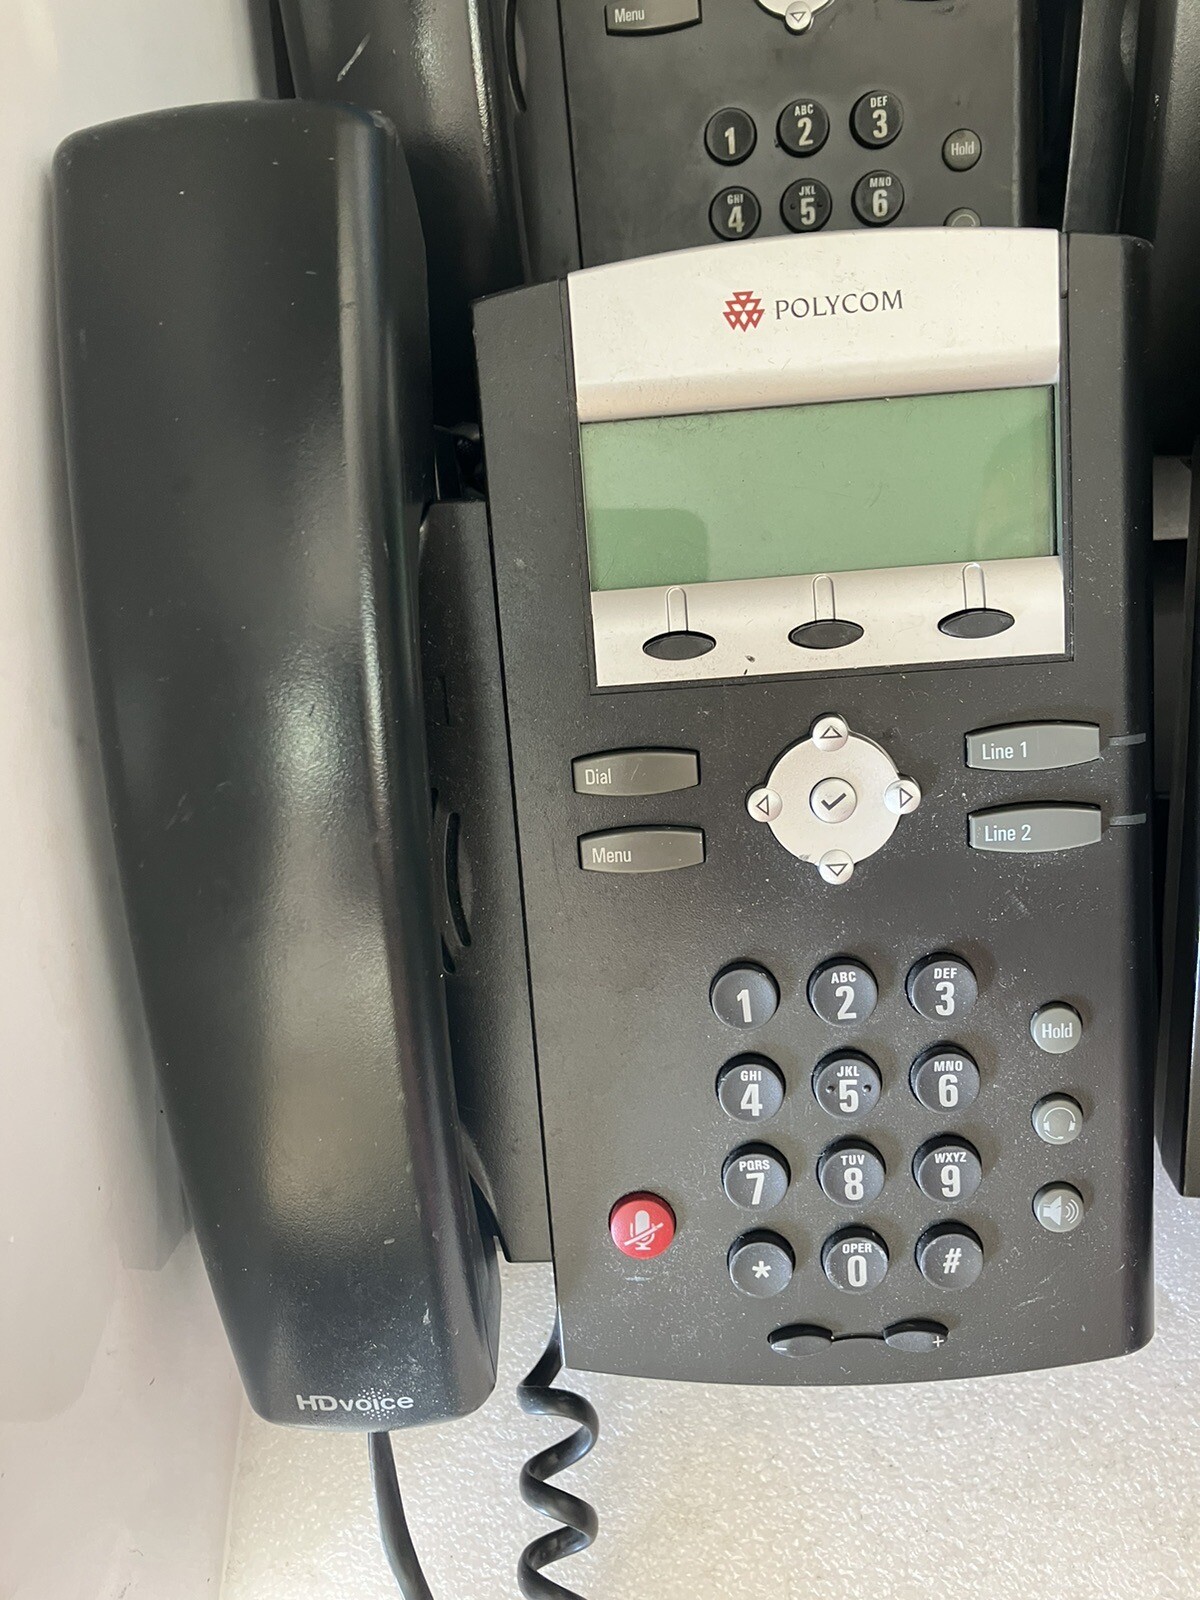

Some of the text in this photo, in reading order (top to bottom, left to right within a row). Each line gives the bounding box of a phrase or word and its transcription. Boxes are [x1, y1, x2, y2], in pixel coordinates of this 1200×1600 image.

[614, 8, 645, 23] Menu
[794, 105, 814, 116] ABC
[870, 97, 888, 107] DEF
[798, 118, 813, 146] 2
[872, 110, 888, 138] 3
[724, 127, 736, 155] 1
[950, 141, 975, 156] Hold
[869, 177, 892, 187] MNO
[727, 195, 744, 204] GHI
[799, 186, 817, 196] JKL
[800, 198, 816, 226] 5
[872, 190, 888, 217] 6
[728, 206, 745, 232] 4
[775, 289, 904, 320] POLYCOM
[982, 742, 1028, 760] Line 1
[585, 769, 612, 785] Dial
[984, 824, 1032, 842] Line 2
[592, 847, 632, 863] Menu
[831, 972, 856, 983] ABC
[933, 968, 957, 979] DEF
[736, 989, 752, 1023] 1
[835, 985, 857, 1020] 2
[934, 981, 955, 1016] 3
[1042, 1023, 1073, 1039] Hold
[836, 1066, 860, 1077] JKL
[934, 1061, 963, 1072] MNO
[740, 1070, 762, 1081] GHI
[838, 1079, 860, 1113] 5
[937, 1073, 959, 1108] 6
[740, 1084, 763, 1116] 4
[738, 1160, 770, 1171] PQRS
[841, 1155, 865, 1166] TUV
[934, 1152, 967, 1163] WXYZ
[746, 1173, 765, 1205] 7
[843, 1168, 864, 1201] 8
[941, 1165, 962, 1197] 9
[842, 1243, 873, 1254] OPER
[846, 1255, 867, 1287] 0
